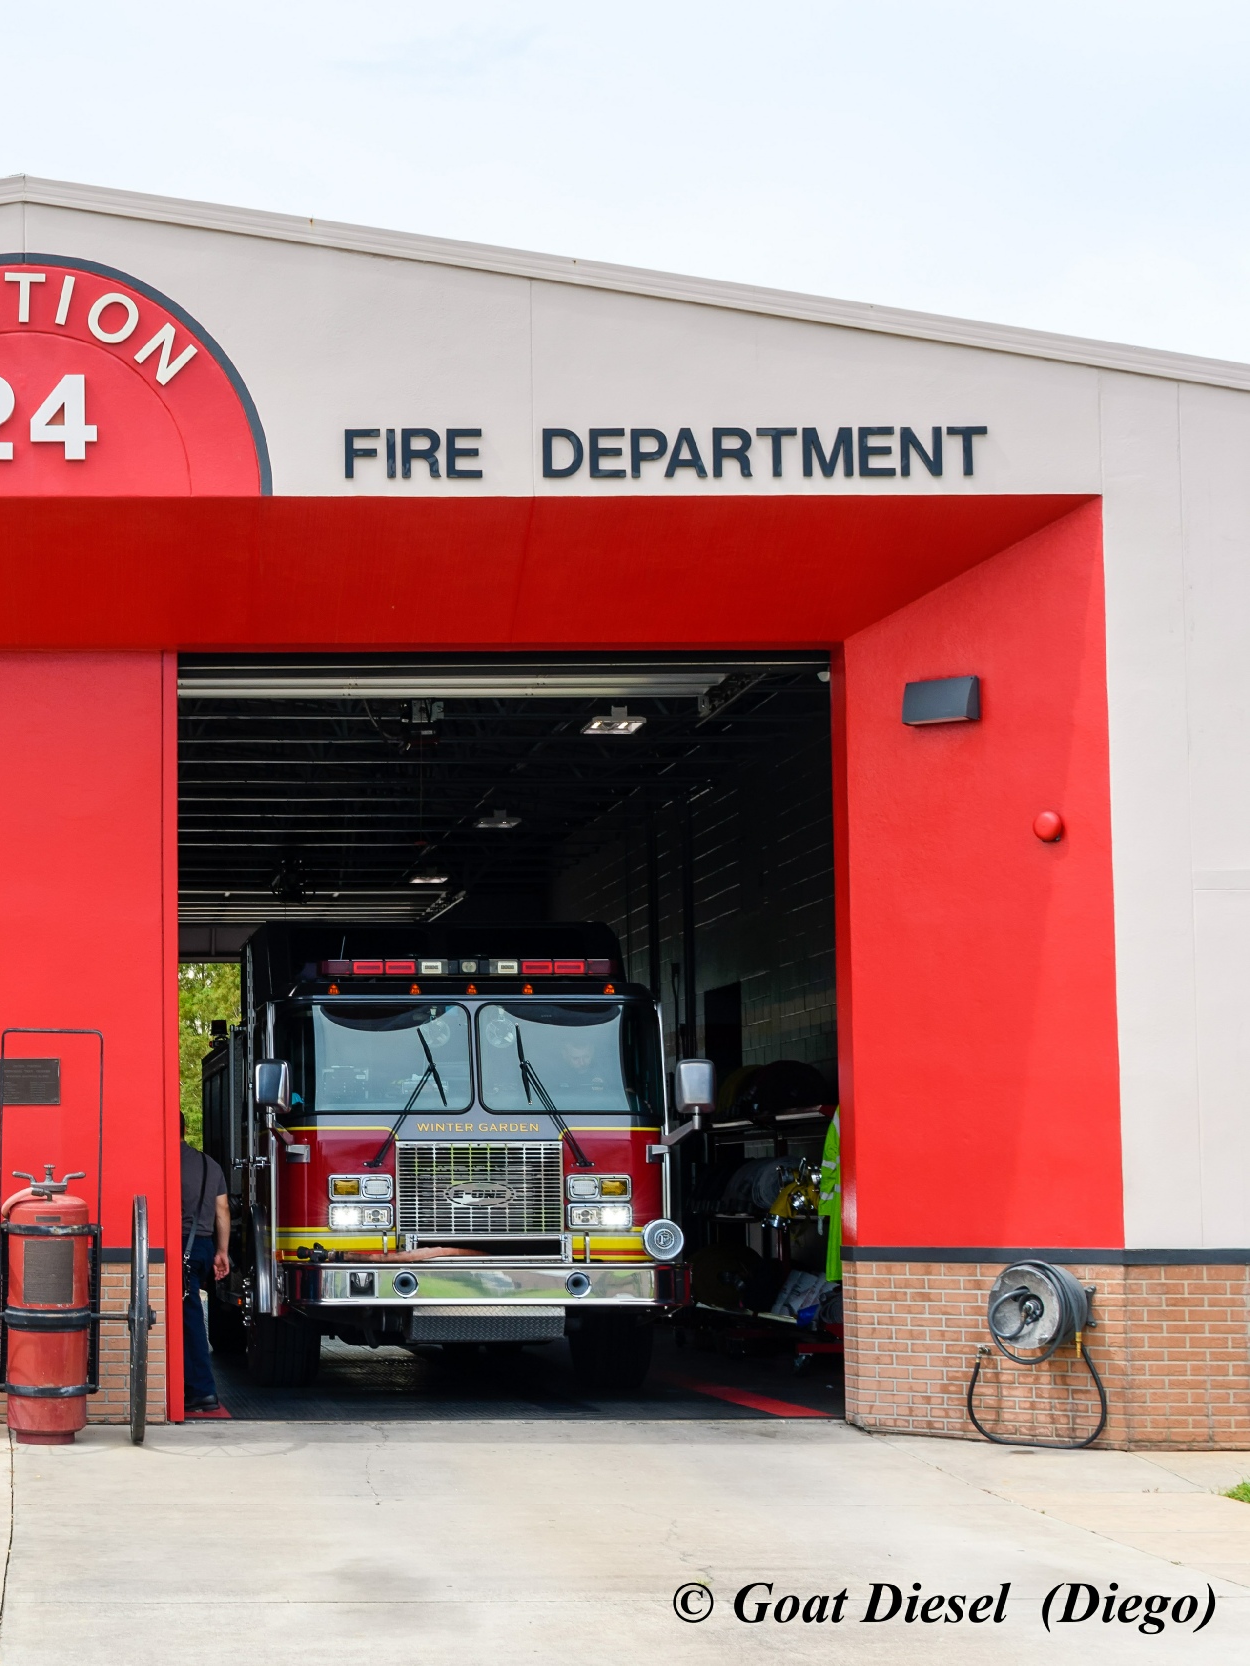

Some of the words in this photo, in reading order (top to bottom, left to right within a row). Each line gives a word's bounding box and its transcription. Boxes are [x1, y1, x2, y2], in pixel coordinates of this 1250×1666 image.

[344, 427, 484, 479] FIRE
[541, 425, 988, 479] DEPARTMENT
[417, 1123, 474, 1132] WINTER
[478, 1123, 540, 1132] GARDEN
[452, 1189, 508, 1199] E-ONE
